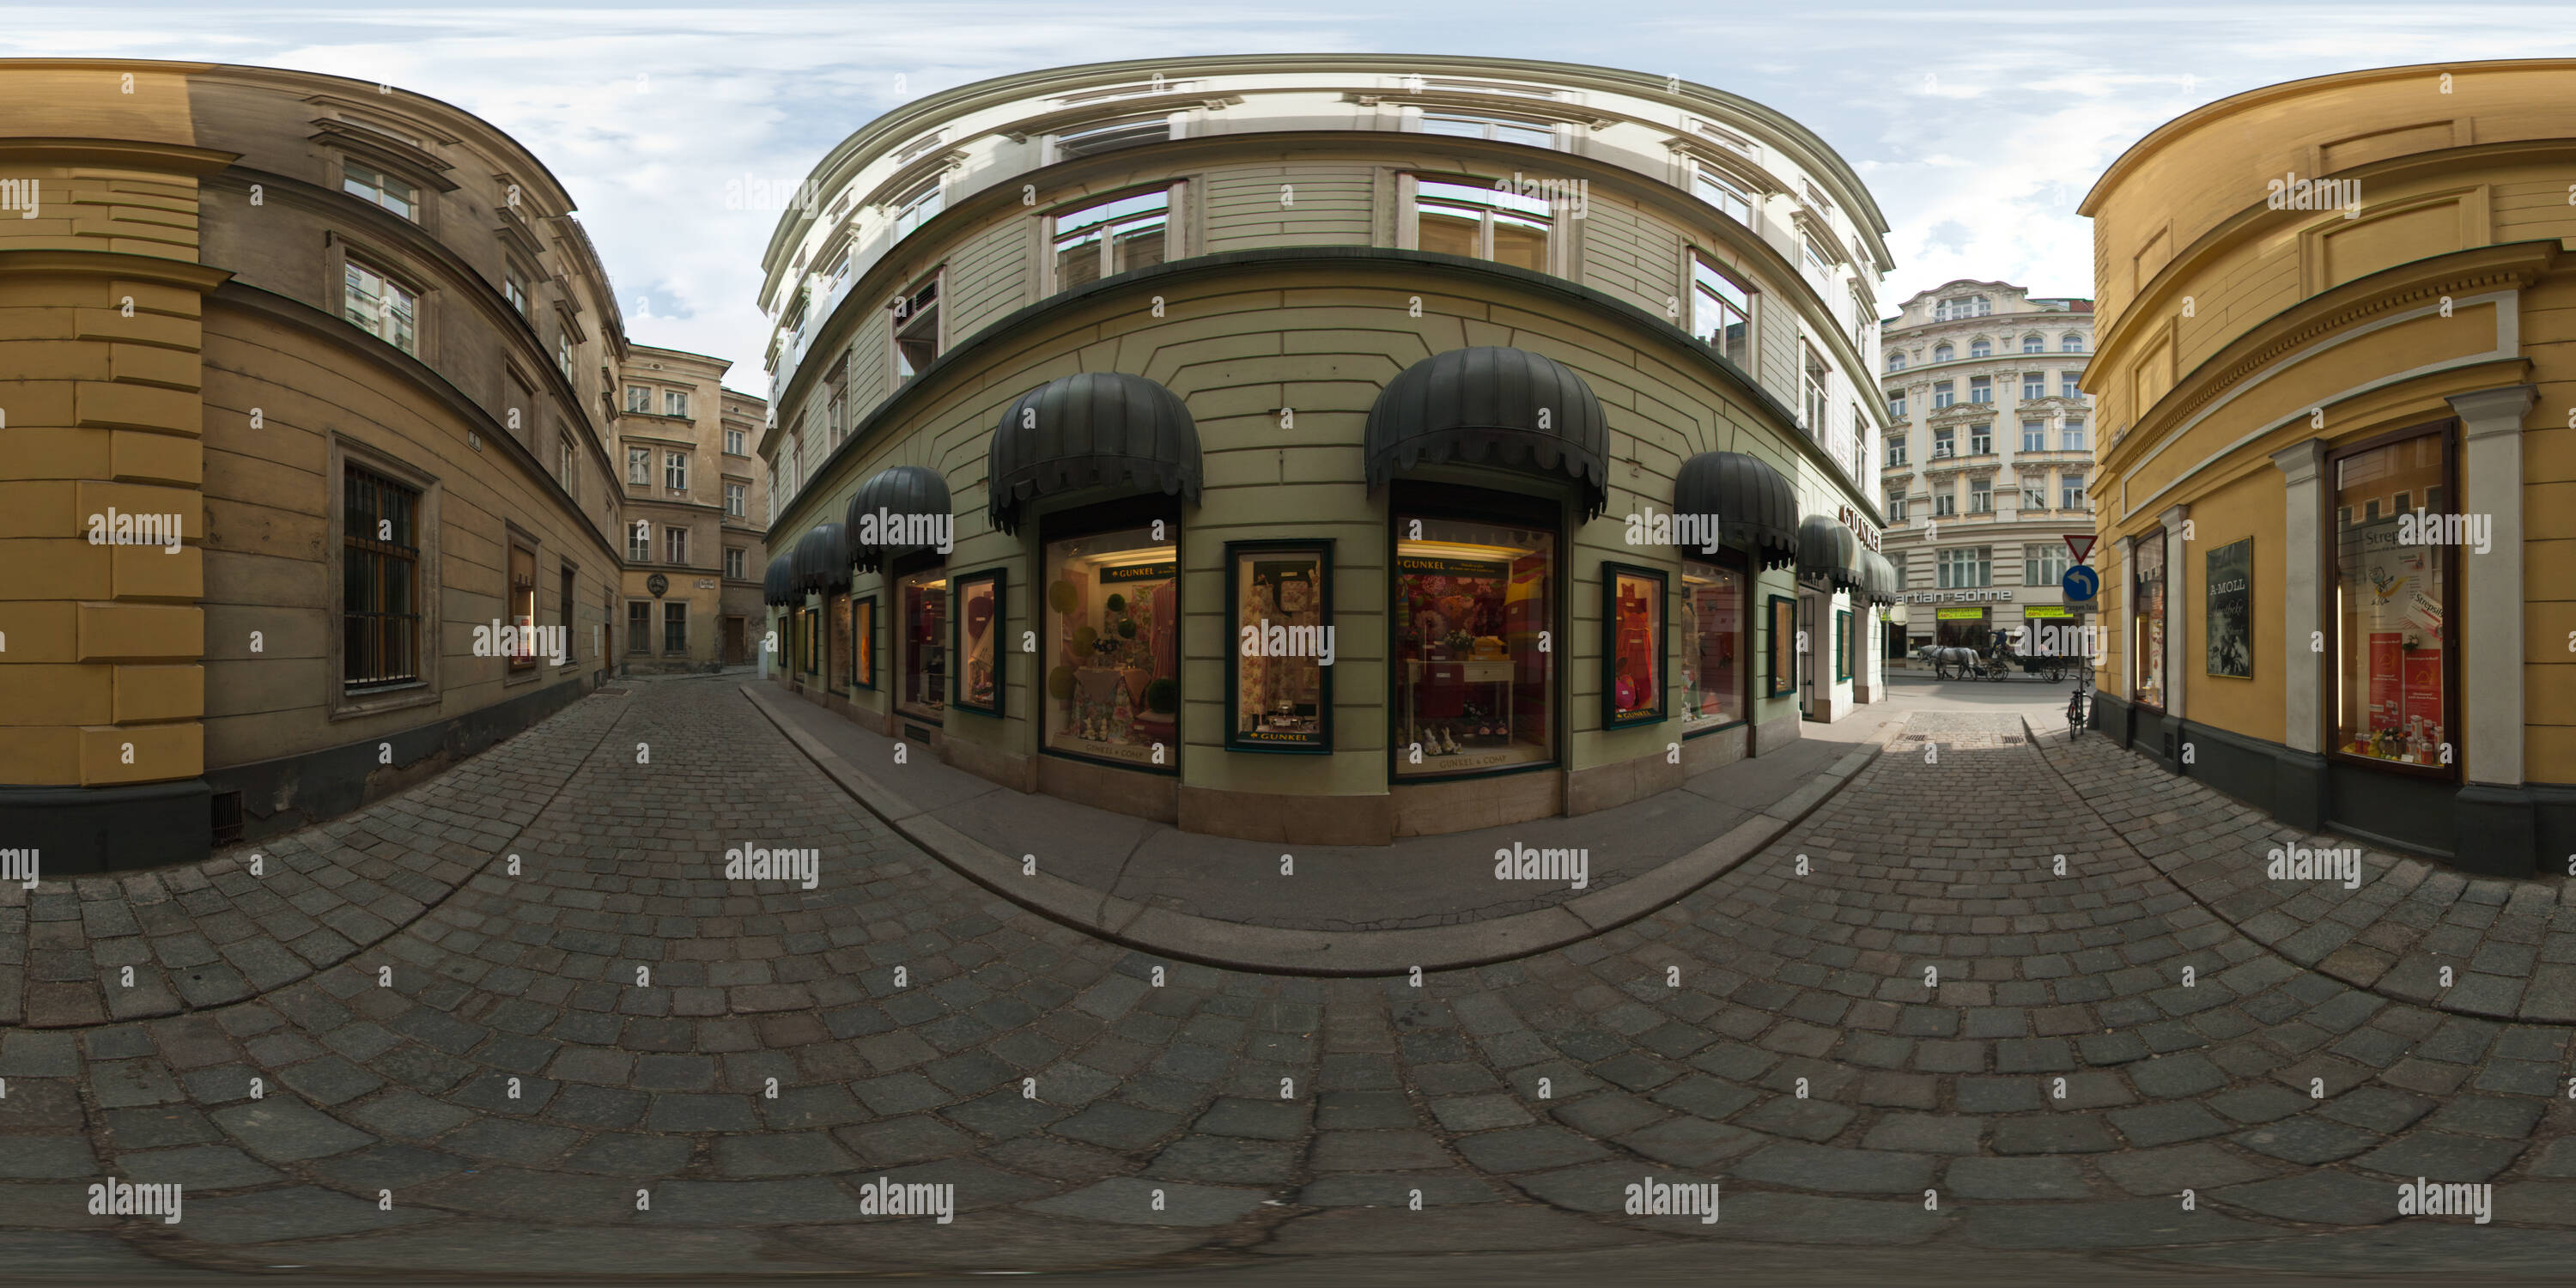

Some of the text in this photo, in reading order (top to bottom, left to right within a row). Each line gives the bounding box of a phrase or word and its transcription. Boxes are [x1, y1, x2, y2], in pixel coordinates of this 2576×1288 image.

[1843, 505, 1881, 555] GUNKEL
[1403, 559, 1445, 570] GUNKEL
[1119, 567, 1154, 578] GUNKEL
[1894, 588, 2013, 603] artian+söhne
[2415, 593, 2445, 619] Strepsils
[1261, 732, 1308, 742] GUNKEL
